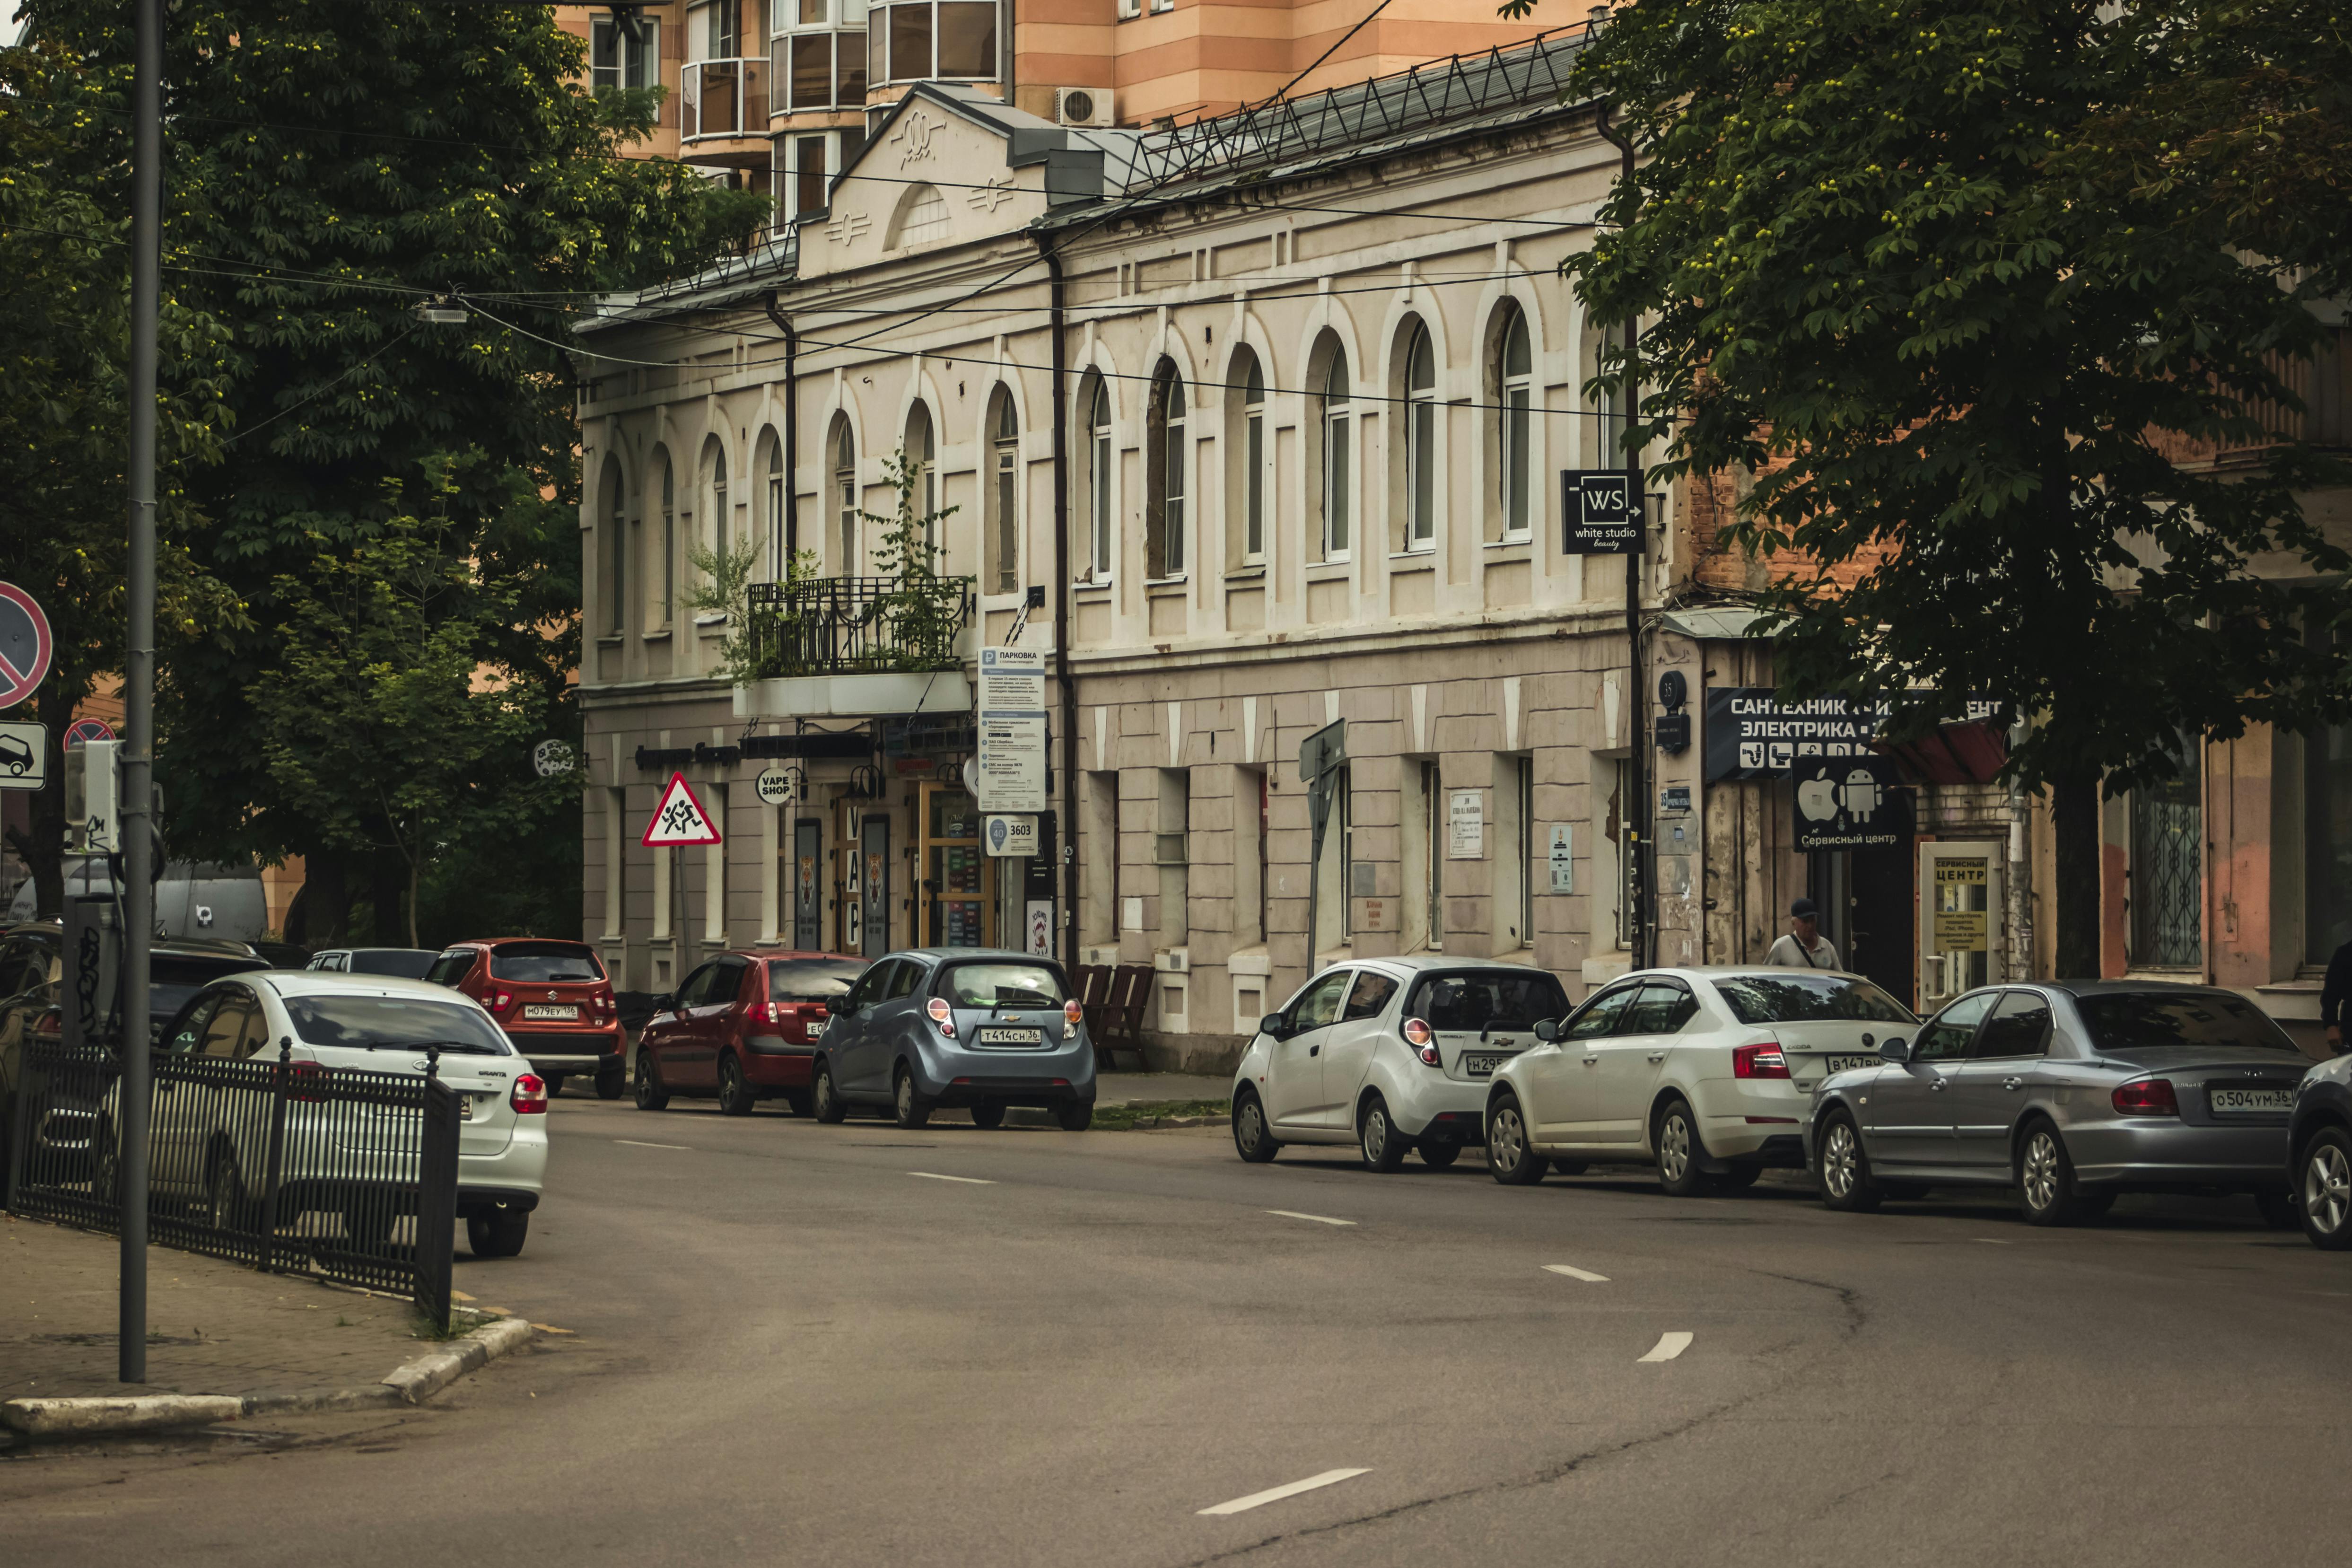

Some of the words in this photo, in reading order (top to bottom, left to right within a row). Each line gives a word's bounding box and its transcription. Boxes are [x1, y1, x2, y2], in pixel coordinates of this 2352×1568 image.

[1587, 490, 1623, 510] WS
[1575, 528, 1602, 537] white
[1606, 527, 1636, 537] studio
[1593, 538, 1620, 551] beauty
[1664, 683, 1672, 697] 35
[1731, 699, 1860, 715] САНЕХНИК
[1741, 721, 1856, 737] ЭЛЕКТРИКА
[762, 777, 789, 785] VAPE
[762, 786, 790, 795] SHOP
[1661, 793, 1667, 806] 35
[993, 829, 1004, 838] 40
[1010, 825, 1031, 835] 3603
[1801, 833, 1862, 847] Сервисный
[1866, 834, 1896, 844] центр
[1937, 870, 1984, 881] ЦЕНТР
[528, 1006, 560, 1015] М079ЕУ
[985, 1030, 1025, 1041] Т414СН
[2216, 1092, 2272, 1106] О504УМ
[2274, 1091, 2288, 1102] 36
